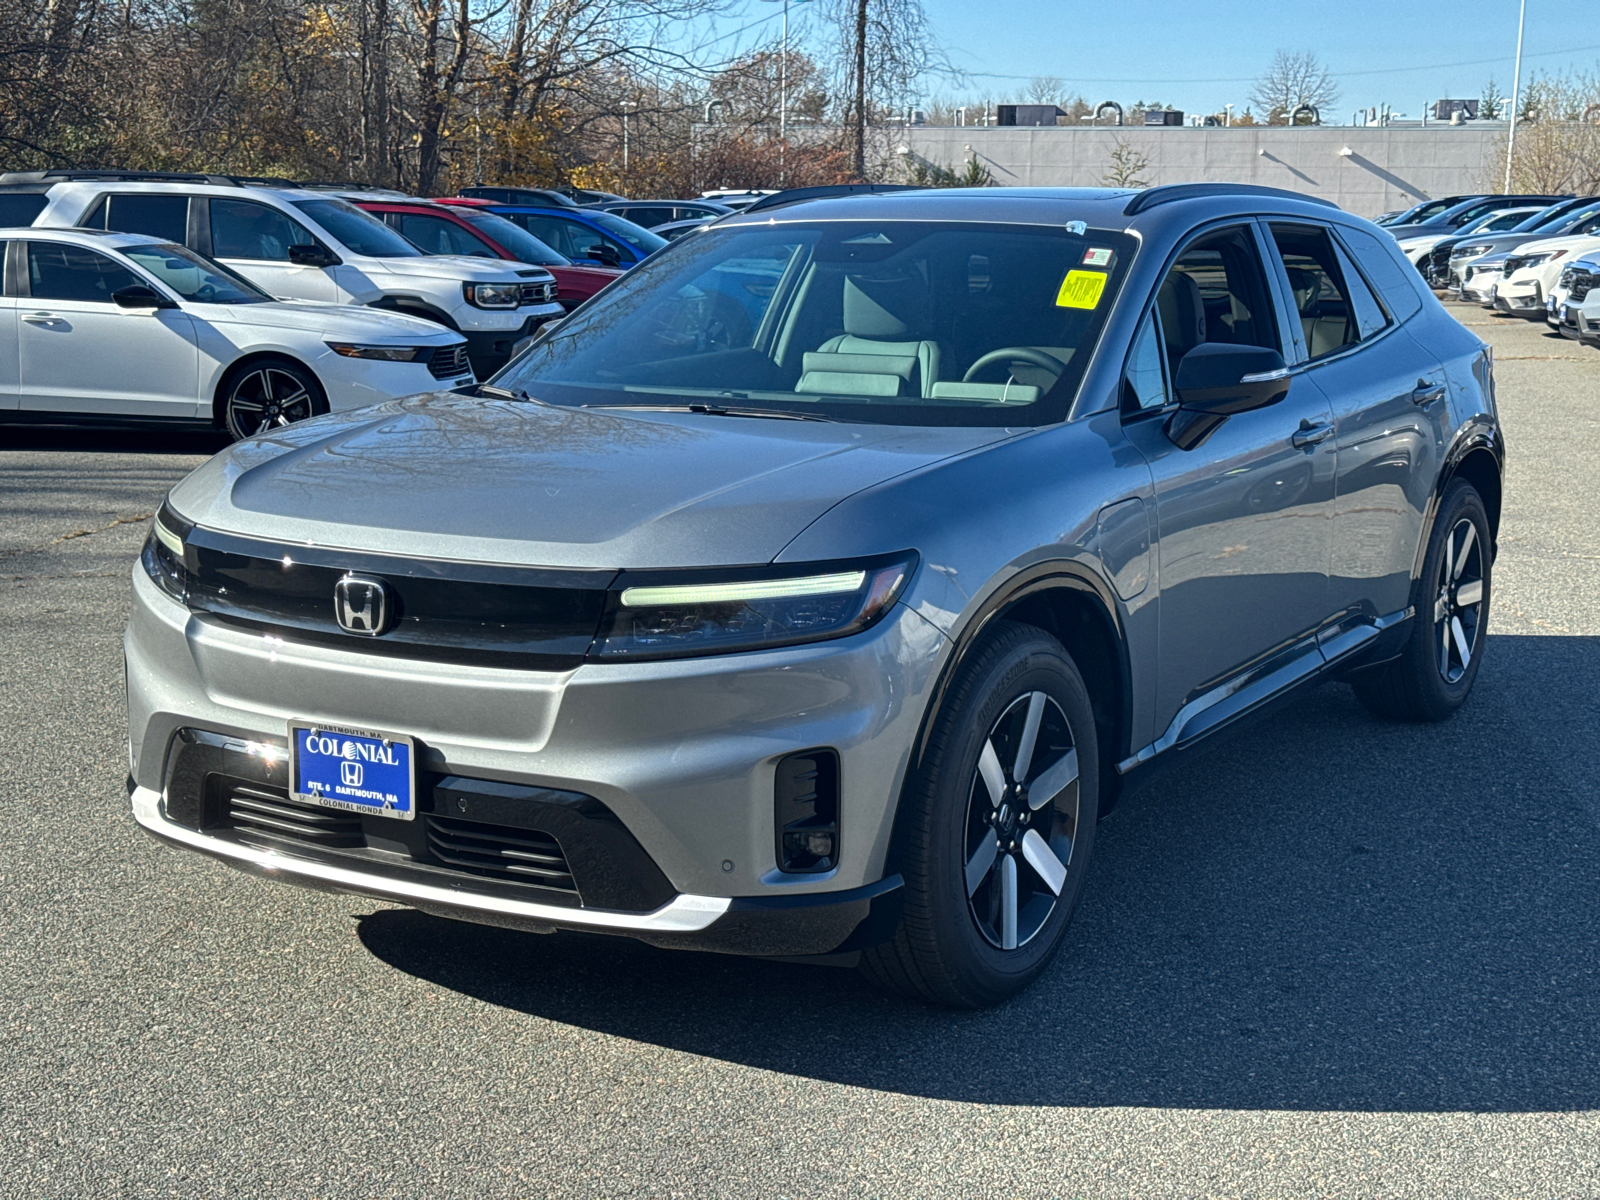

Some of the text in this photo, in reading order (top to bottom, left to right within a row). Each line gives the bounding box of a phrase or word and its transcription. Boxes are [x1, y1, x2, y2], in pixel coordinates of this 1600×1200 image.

[977, 656, 1029, 727] BRIDGESTONE
[306, 735, 399, 766] COLONIAL
[307, 781, 398, 803] RTE. 6 DARTMOUTH, MA
[319, 798, 383, 815] COLONIAL HONDA
